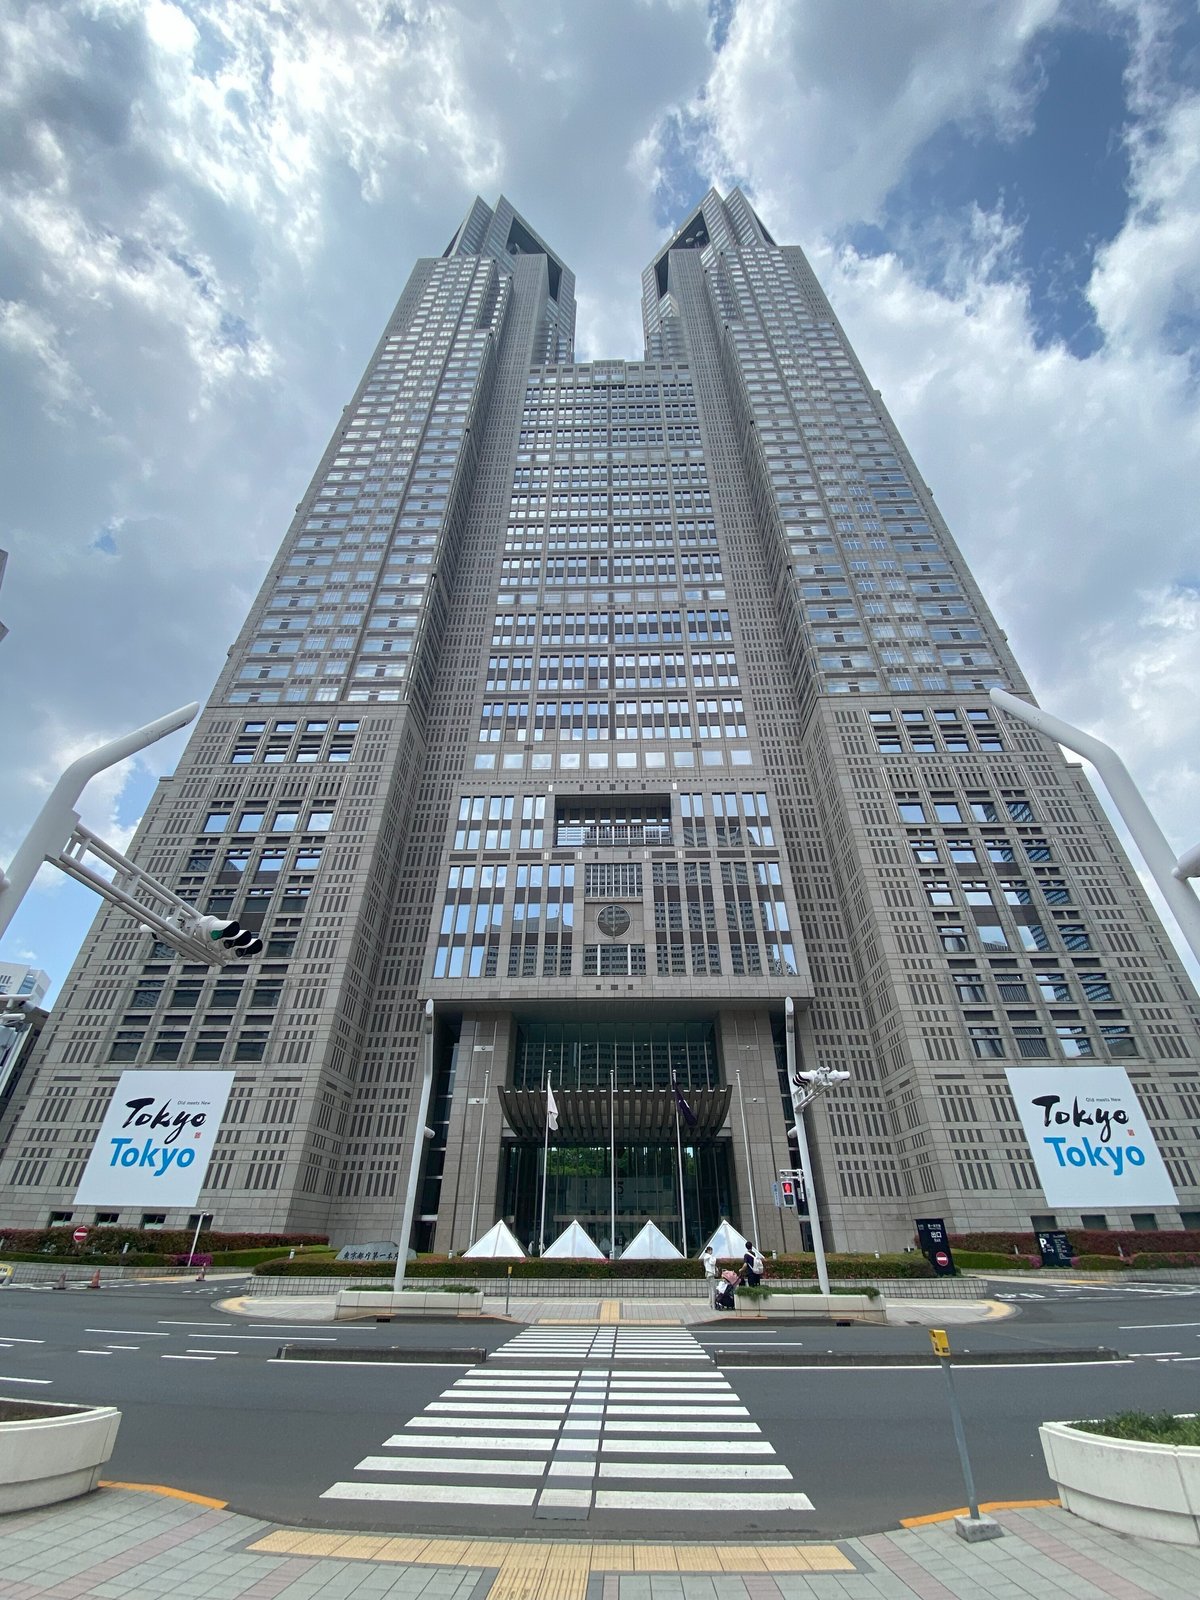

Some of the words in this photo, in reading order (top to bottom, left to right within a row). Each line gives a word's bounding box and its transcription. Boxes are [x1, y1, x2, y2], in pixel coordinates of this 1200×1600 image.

[122, 1097, 206, 1144] Tokyo
[1032, 1095, 1129, 1143] Tokyo
[109, 1138, 195, 1176] Tokyo
[1043, 1136, 1145, 1176] Tokyo
[1039, 1238, 1047, 1248] P
